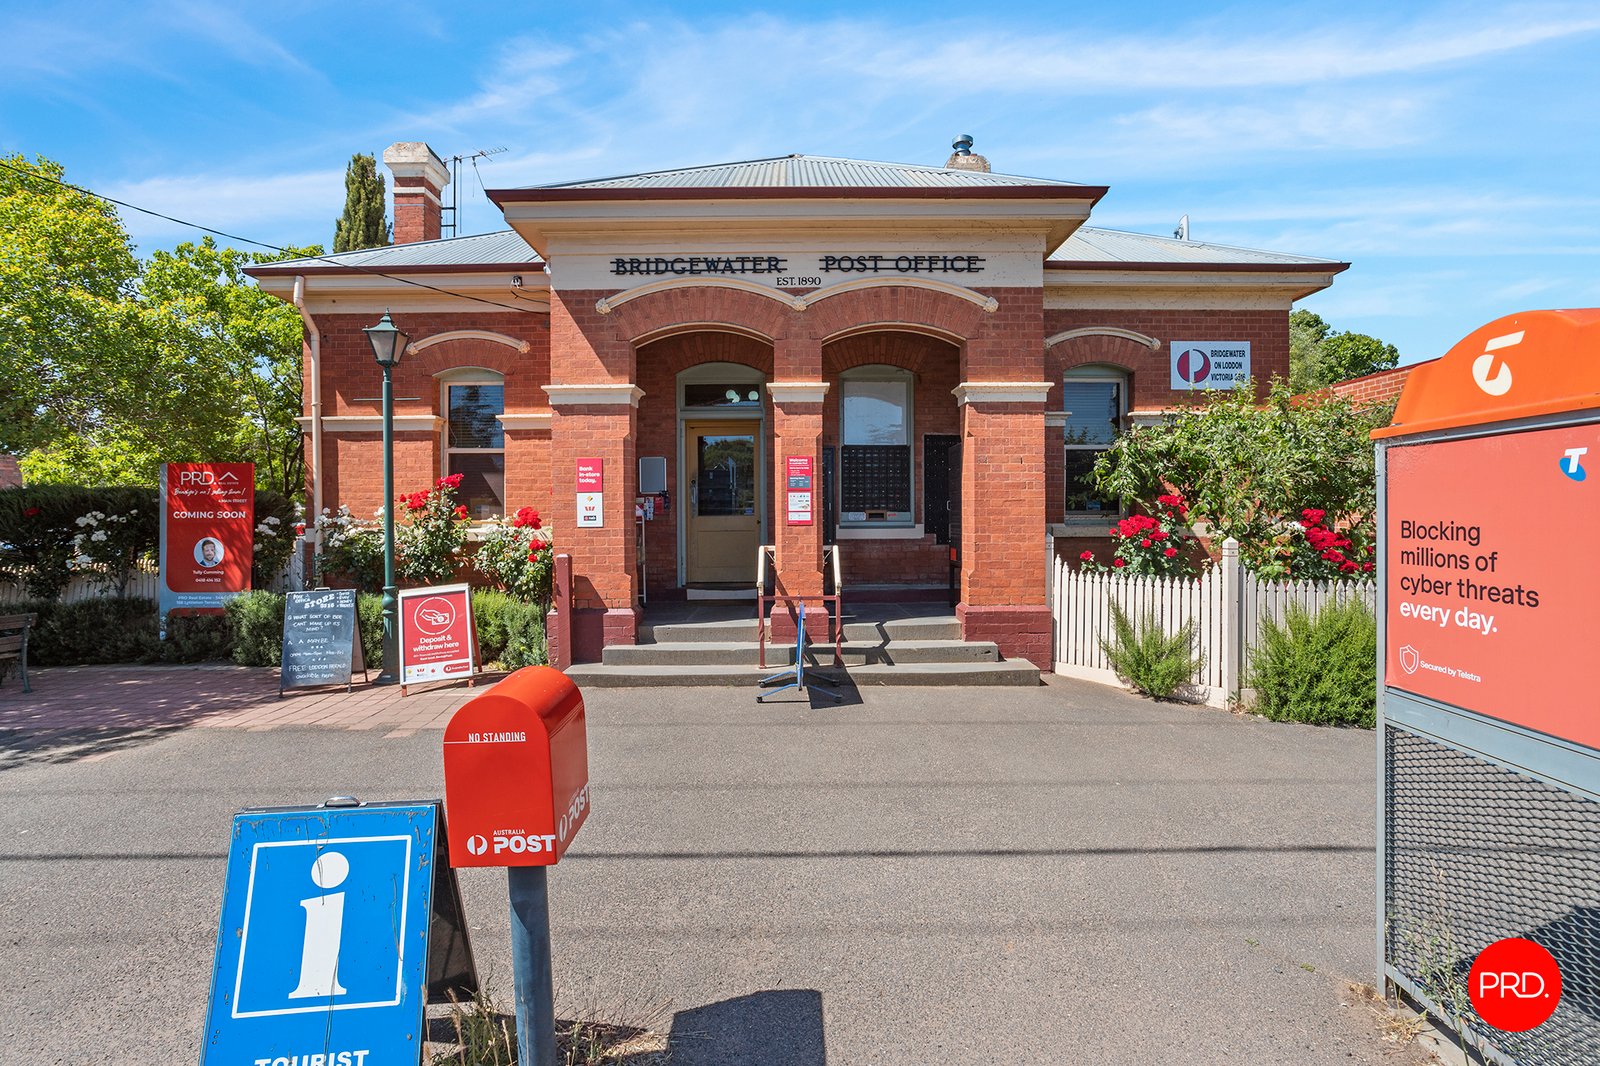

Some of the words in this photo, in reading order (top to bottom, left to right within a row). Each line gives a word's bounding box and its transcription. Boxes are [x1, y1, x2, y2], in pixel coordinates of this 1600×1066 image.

[614, 256, 783, 276] BRIDGEWATER
[824, 255, 884, 273] POST
[895, 255, 980, 273] OFFICE
[776, 276, 796, 286] EST.
[798, 276, 822, 286] 1890
[1210, 349, 1246, 358] BRIDGEWATER
[1213, 361, 1222, 370] ON
[1222, 361, 1243, 370] LODDON
[1400, 520, 1481, 547] Blocking
[1400, 547, 1470, 571] millions
[1475, 551, 1498, 572] of
[1400, 574, 1452, 596] cyber
[1456, 578, 1540, 608] threats
[304, 593, 336, 609] STORE
[1399, 602, 1451, 627] every
[1454, 606, 1498, 635] day.
[413, 642, 443, 652] withdraw
[420, 635, 446, 644] Deposit
[1420, 660, 1447, 675] Secured
[1447, 666, 1457, 677] by
[1457, 669, 1481, 683] Telstra
[468, 733, 480, 742] NO
[483, 732, 526, 742] STANDING
[568, 784, 590, 830] POST
[493, 835, 556, 854] POST
